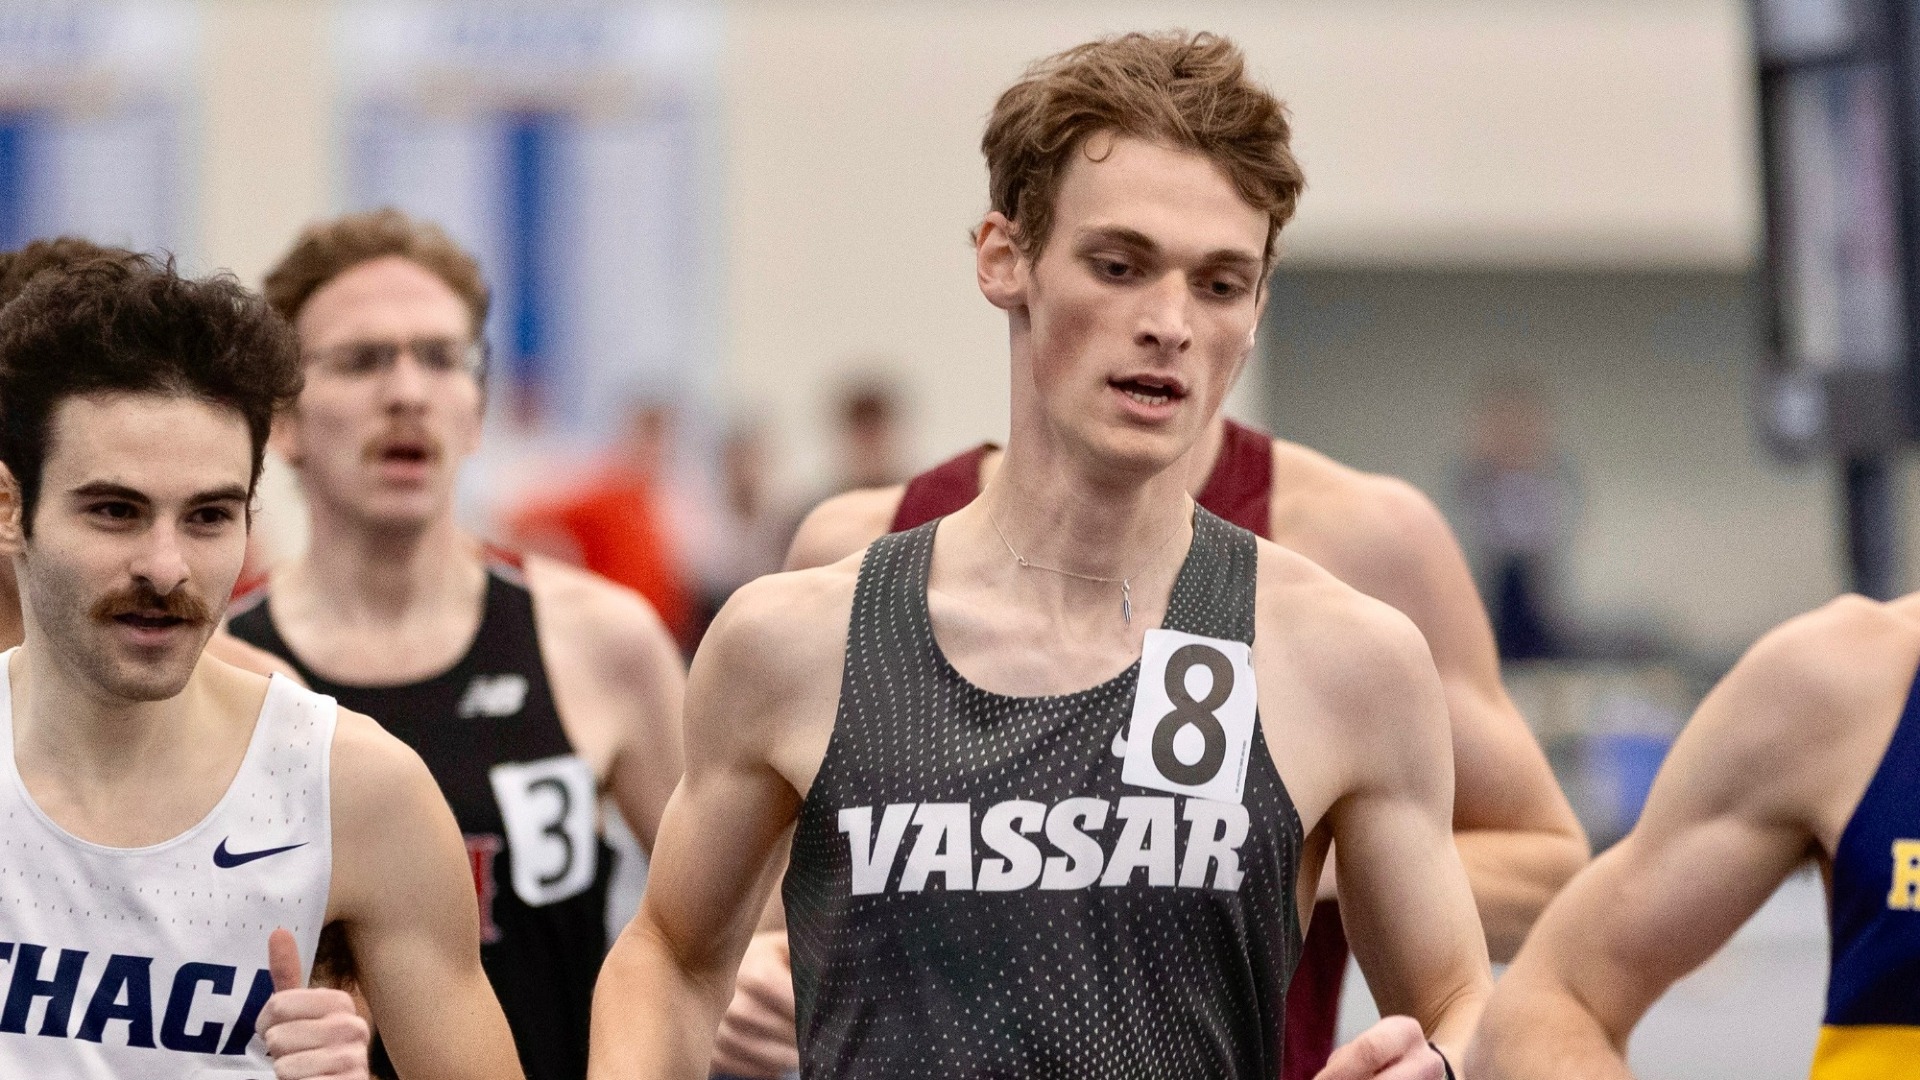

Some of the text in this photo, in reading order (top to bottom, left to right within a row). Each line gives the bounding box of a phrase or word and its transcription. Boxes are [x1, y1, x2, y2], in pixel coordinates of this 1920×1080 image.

[1151, 643, 1235, 786] 8
[525, 776, 575, 888] 3
[838, 796, 1250, 896] VASSAR
